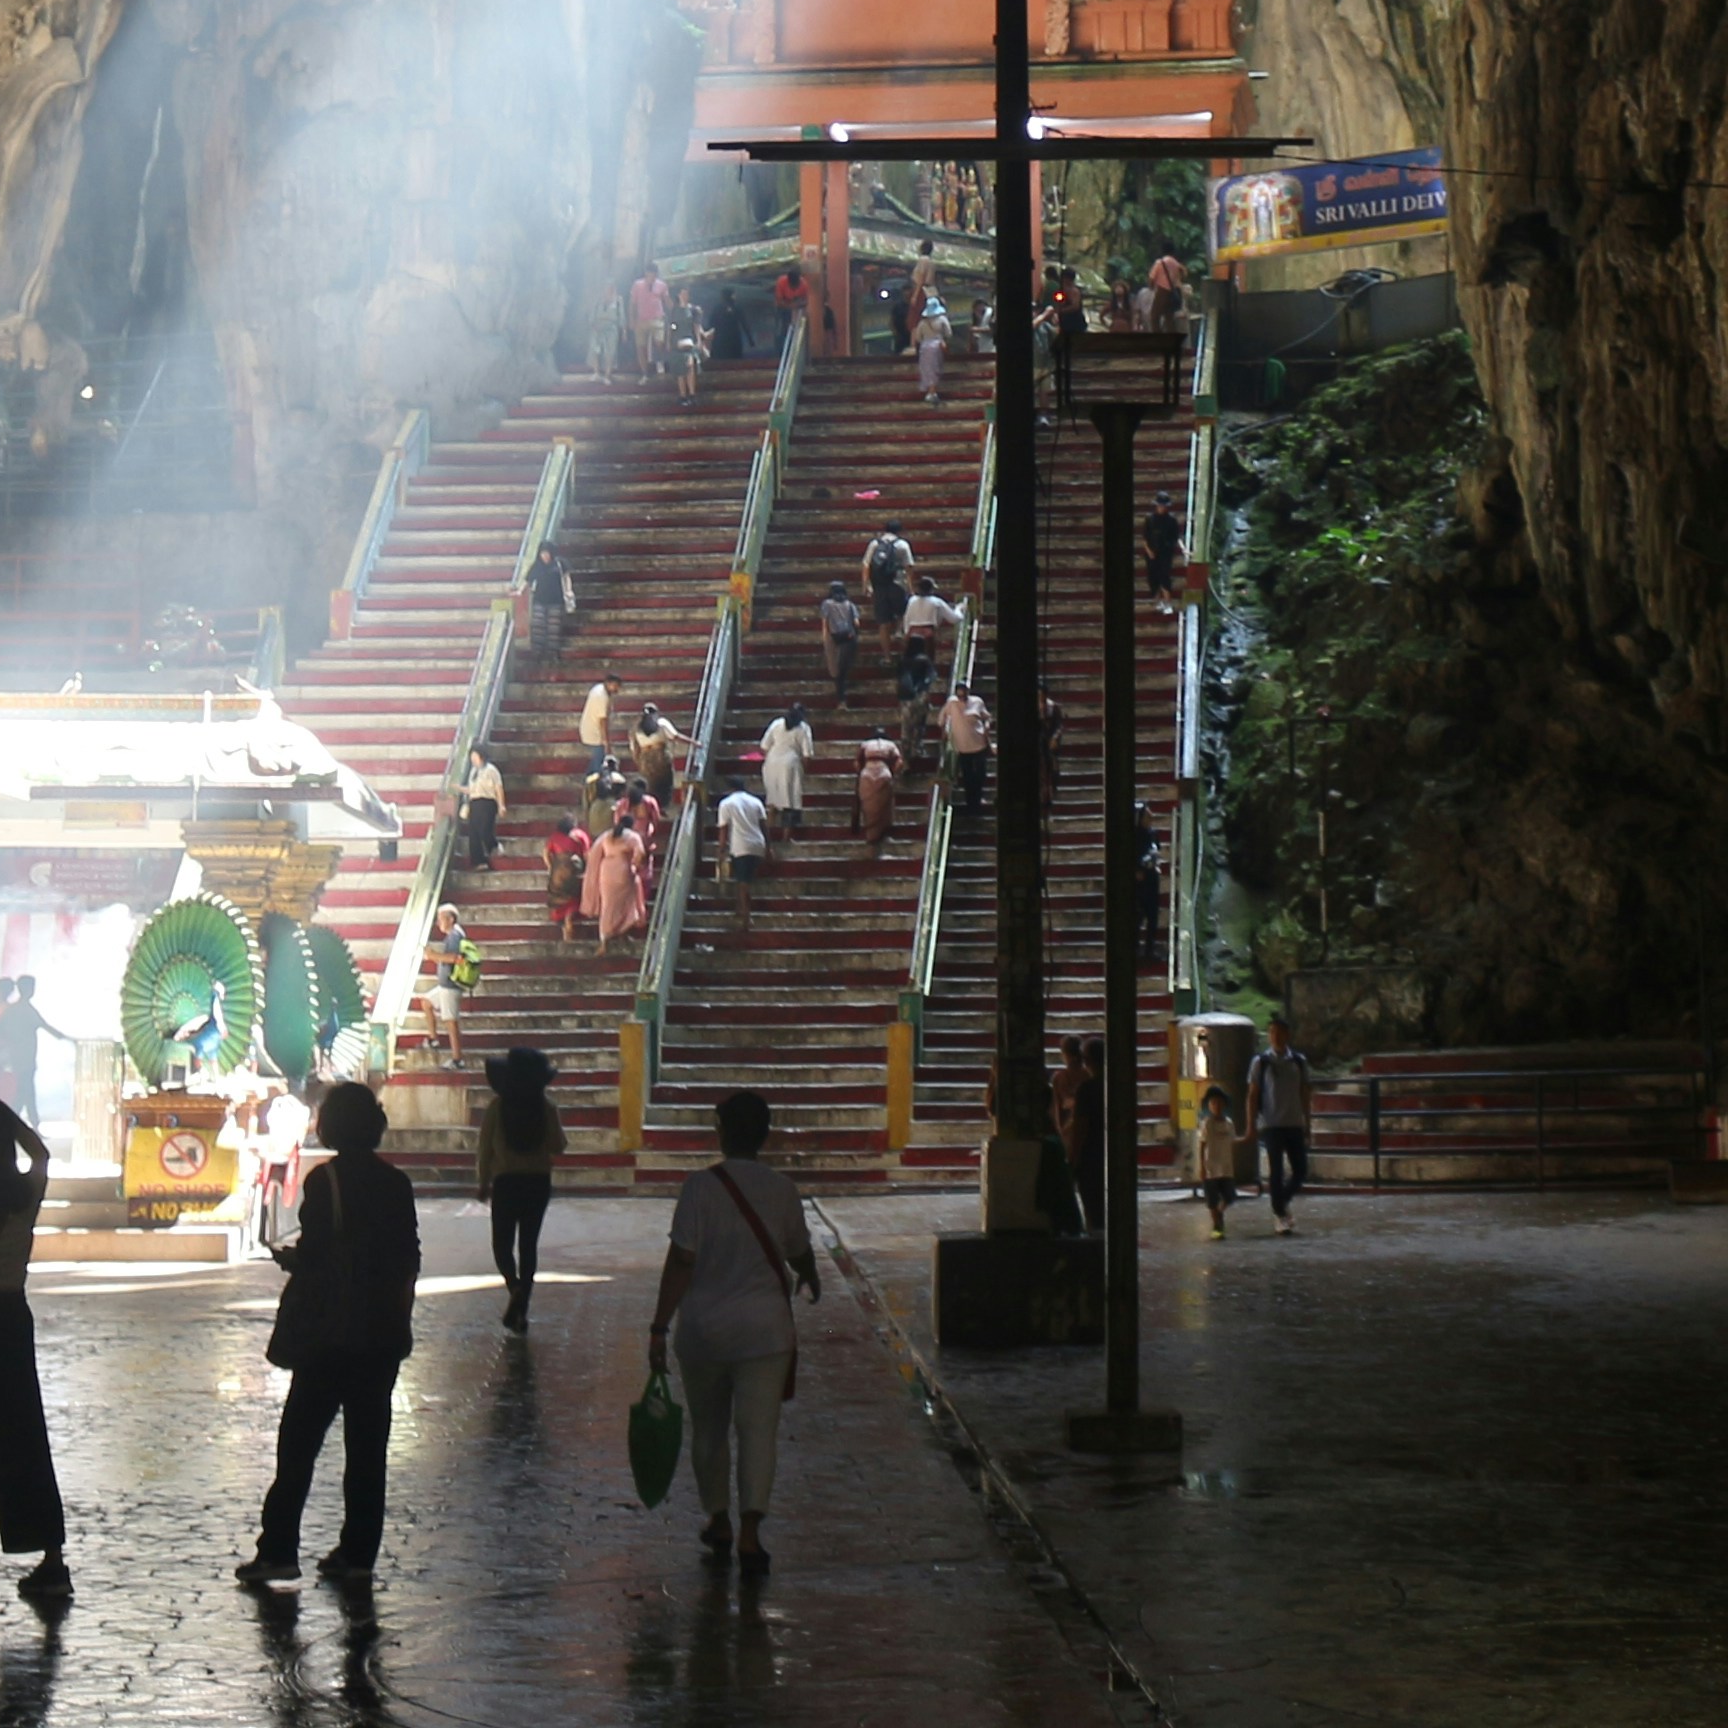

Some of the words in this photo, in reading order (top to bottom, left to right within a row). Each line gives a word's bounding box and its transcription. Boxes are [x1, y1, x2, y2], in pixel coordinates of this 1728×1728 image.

[1315, 205, 1344, 225] SRI
[1347, 198, 1398, 218] VALLI
[139, 1183, 167, 1197] NO
[151, 1202, 178, 1221] NO
